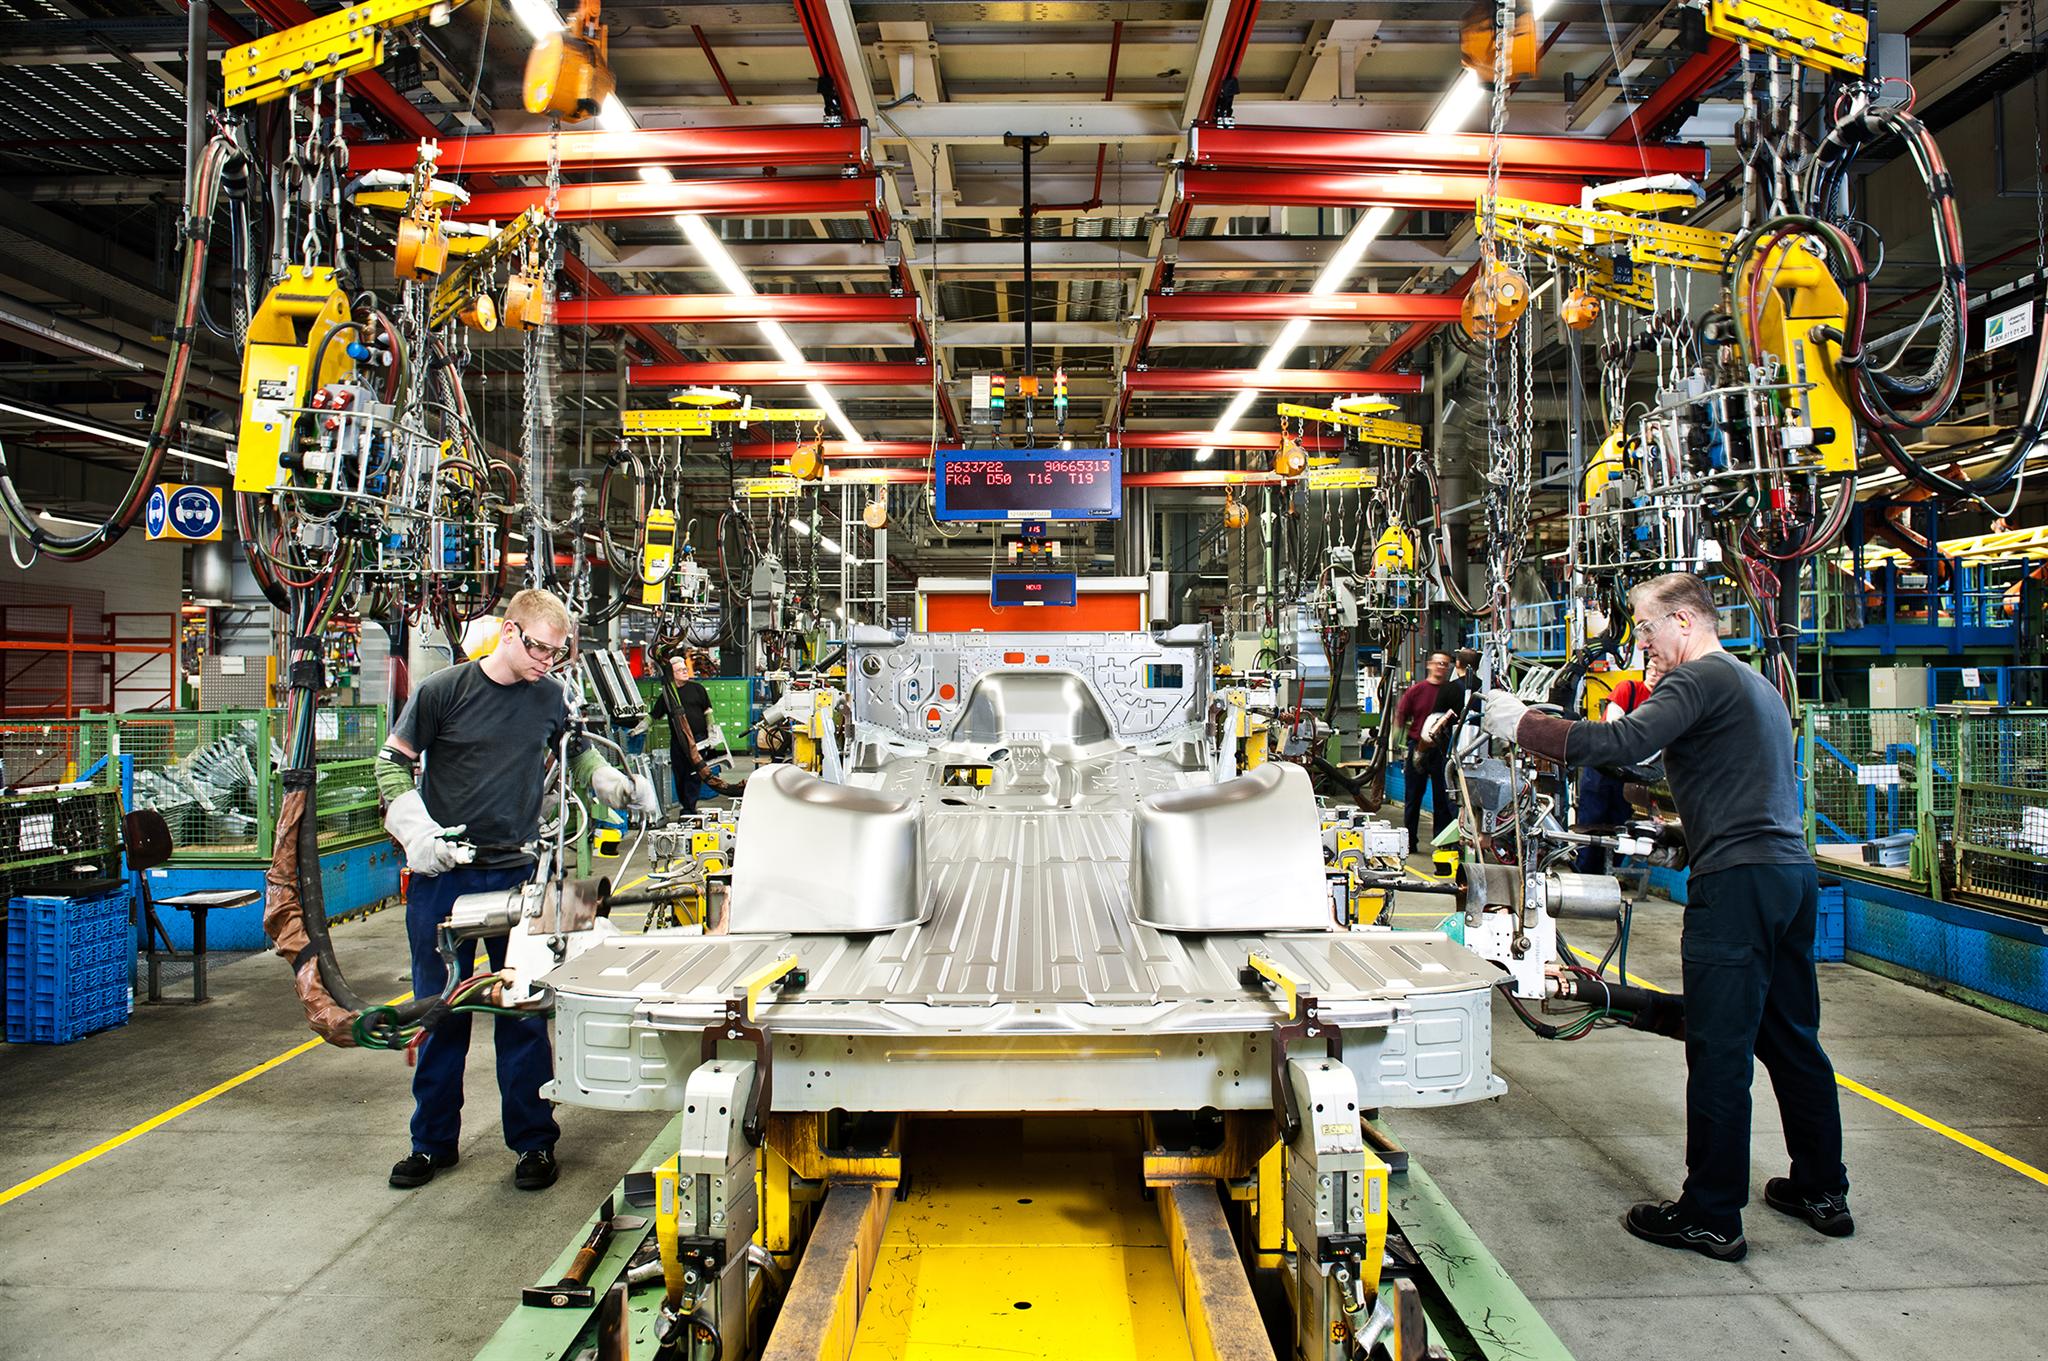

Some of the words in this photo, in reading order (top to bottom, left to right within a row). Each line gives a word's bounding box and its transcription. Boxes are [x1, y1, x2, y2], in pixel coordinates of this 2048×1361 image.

[945, 461, 1004, 473] 2633722
[1044, 461, 1110, 472] 90665313
[945, 474, 971, 485] FKA
[986, 473, 1012, 485] D50
[1028, 473, 1053, 485] T16
[1068, 473, 1094, 485] T19
